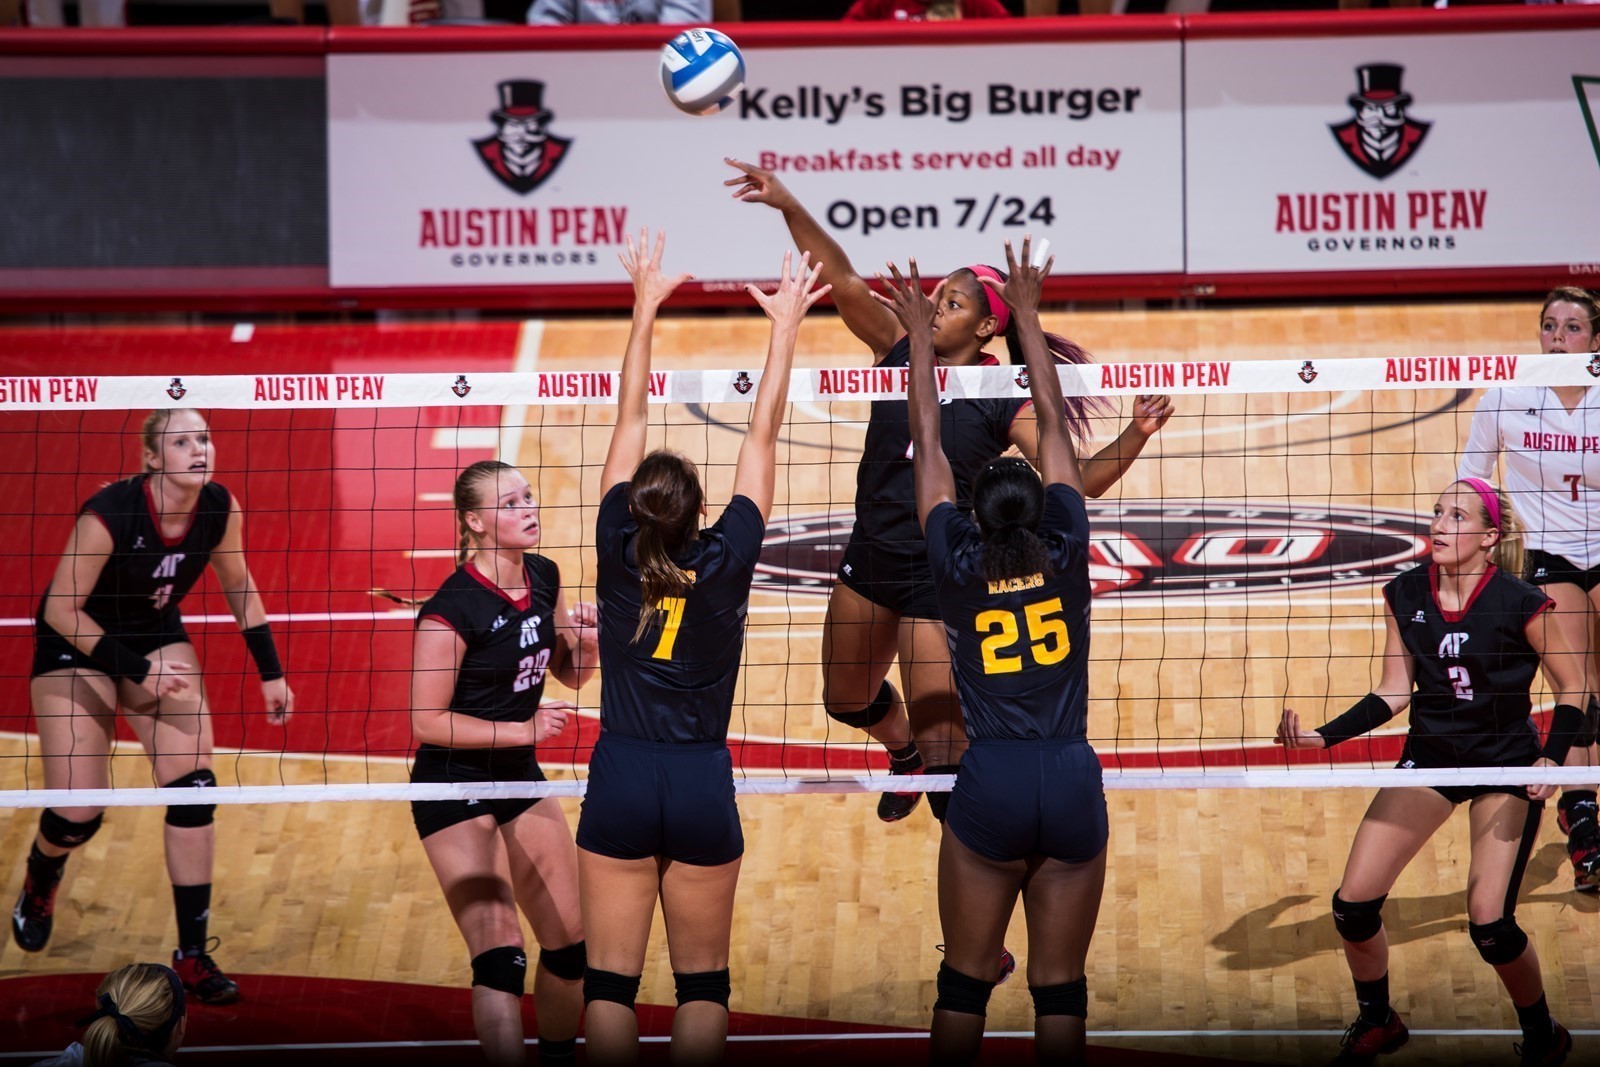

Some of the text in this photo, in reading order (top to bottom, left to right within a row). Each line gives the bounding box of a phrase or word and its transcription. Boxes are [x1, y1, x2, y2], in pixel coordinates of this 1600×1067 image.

[738, 83, 1142, 124] Kelly’s Big Burger
[758, 144, 1121, 173] Breakfast served all day
[826, 194, 1055, 236] Open 7/24
[1275, 190, 1488, 233] AUSTIN PEAY
[419, 207, 628, 248] AUSTIN PEAY
[1307, 236, 1457, 252] GOVERNORS
[451, 251, 598, 268] GOVERNORS
[819, 369, 893, 394] AUSTIN
[1100, 361, 1231, 389] AUSTIN PEAY
[1385, 355, 1518, 383] AUSTIN PEAY
[48, 378, 98, 403] PEAY
[254, 376, 384, 401] AUSTIN PEAY
[538, 373, 612, 397] AUSTIN
[1523, 431, 1577, 453] AUSTIN
[1563, 474, 1582, 502] 7
[152, 553, 186, 578] AP
[987, 572, 1045, 595] RACERS
[519, 615, 541, 648] AP
[975, 597, 1071, 674] 25
[1438, 632, 1470, 658] AP
[513, 648, 551, 693] 29
[1448, 666, 1474, 701] 2
